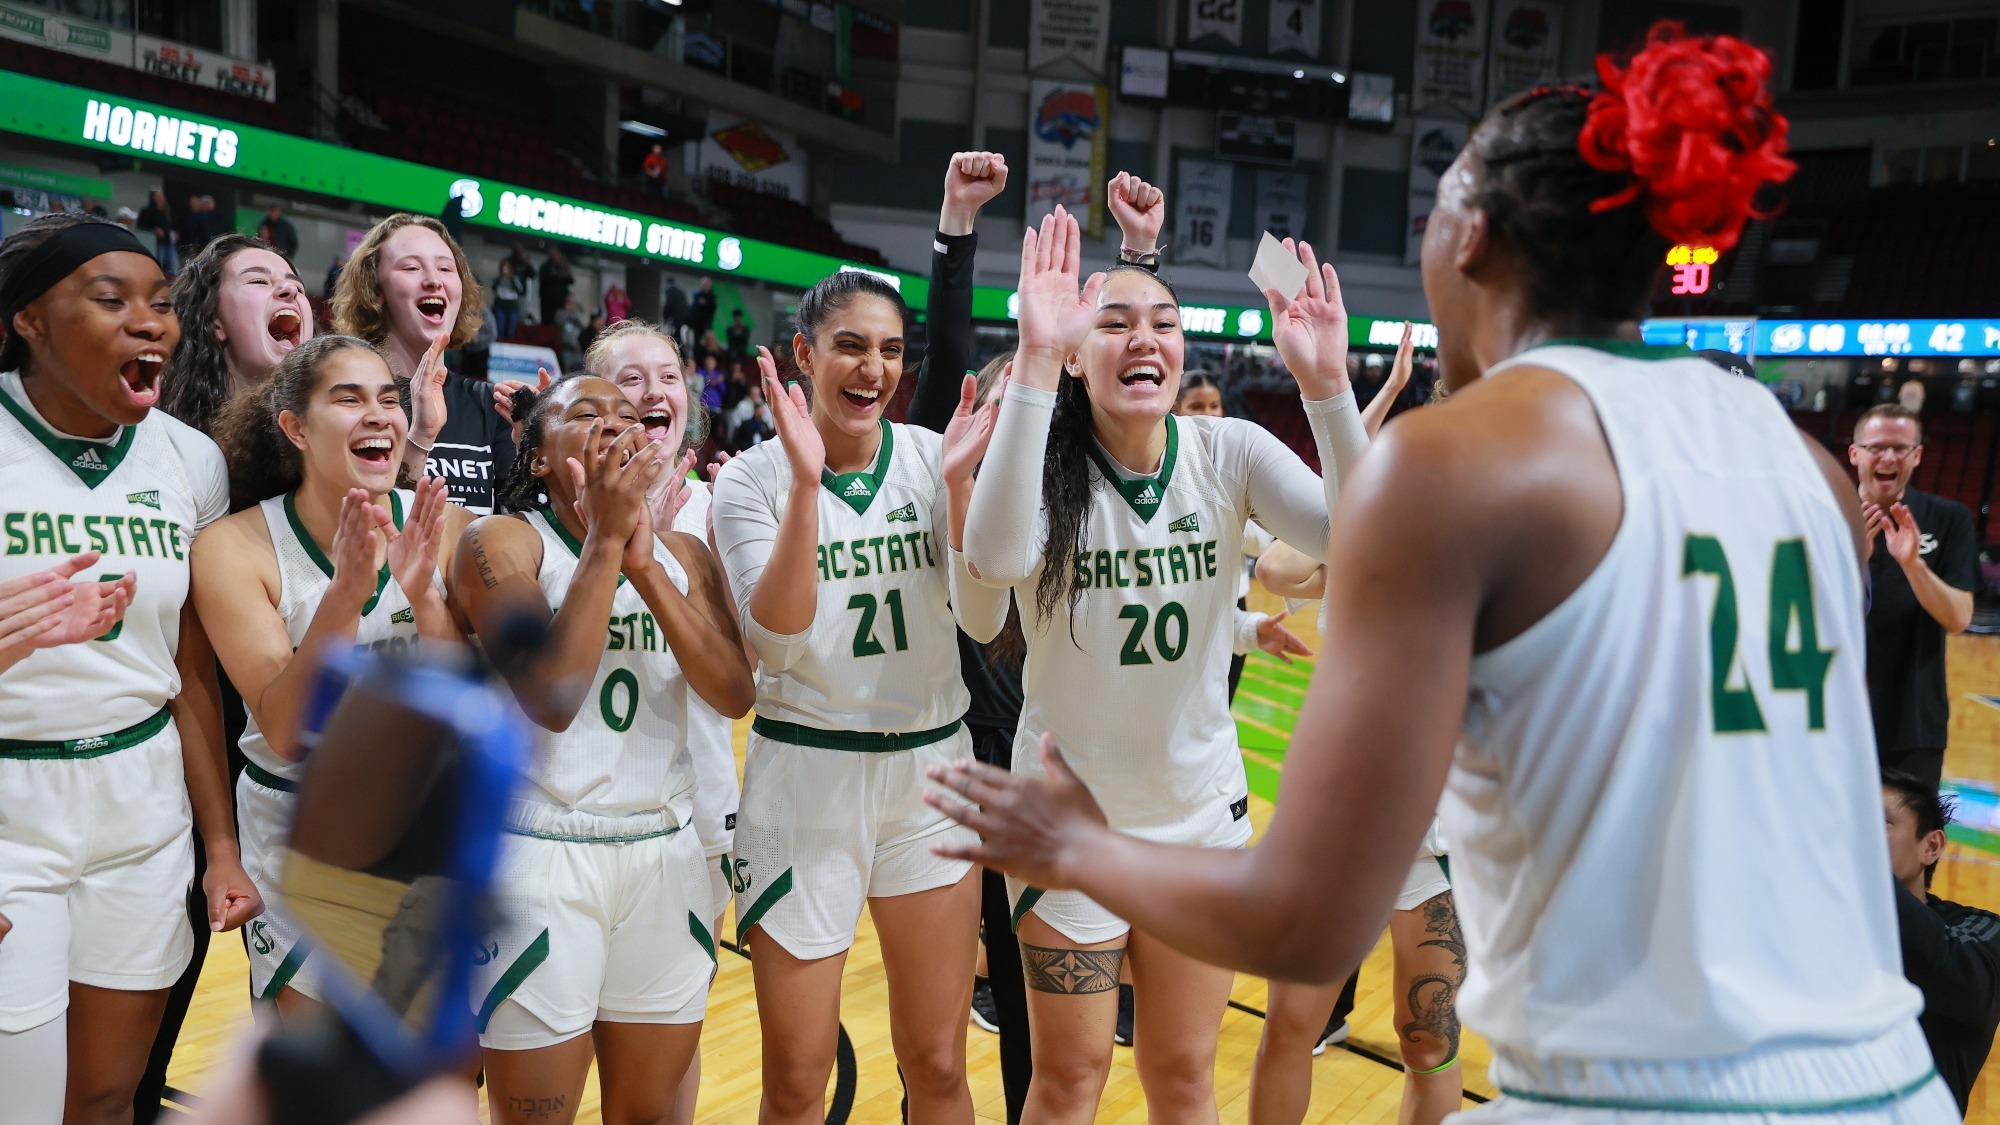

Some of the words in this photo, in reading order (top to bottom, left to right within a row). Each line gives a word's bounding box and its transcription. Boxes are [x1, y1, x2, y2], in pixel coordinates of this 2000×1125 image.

[83, 99, 239, 168] HORNETS
[499, 191, 642, 250] SACRAMENTO
[646, 224, 705, 262] STATE
[1190, 220, 1214, 247] 16
[1672, 263, 1710, 294] 30
[1928, 323, 1966, 352] 42
[72, 459, 108, 472] adidas
[844, 489, 871, 498] adidas
[1134, 496, 1159, 505] adidas
[4, 511, 82, 557] SAC
[83, 514, 184, 562] STATE
[1077, 548, 1132, 590] SAC
[1133, 539, 1218, 588] STATE
[845, 588, 909, 659] 21
[1117, 601, 1189, 667] 20
[1680, 532, 1840, 735] 24
[600, 667, 639, 734] 0
[73, 739, 109, 752] adidas
